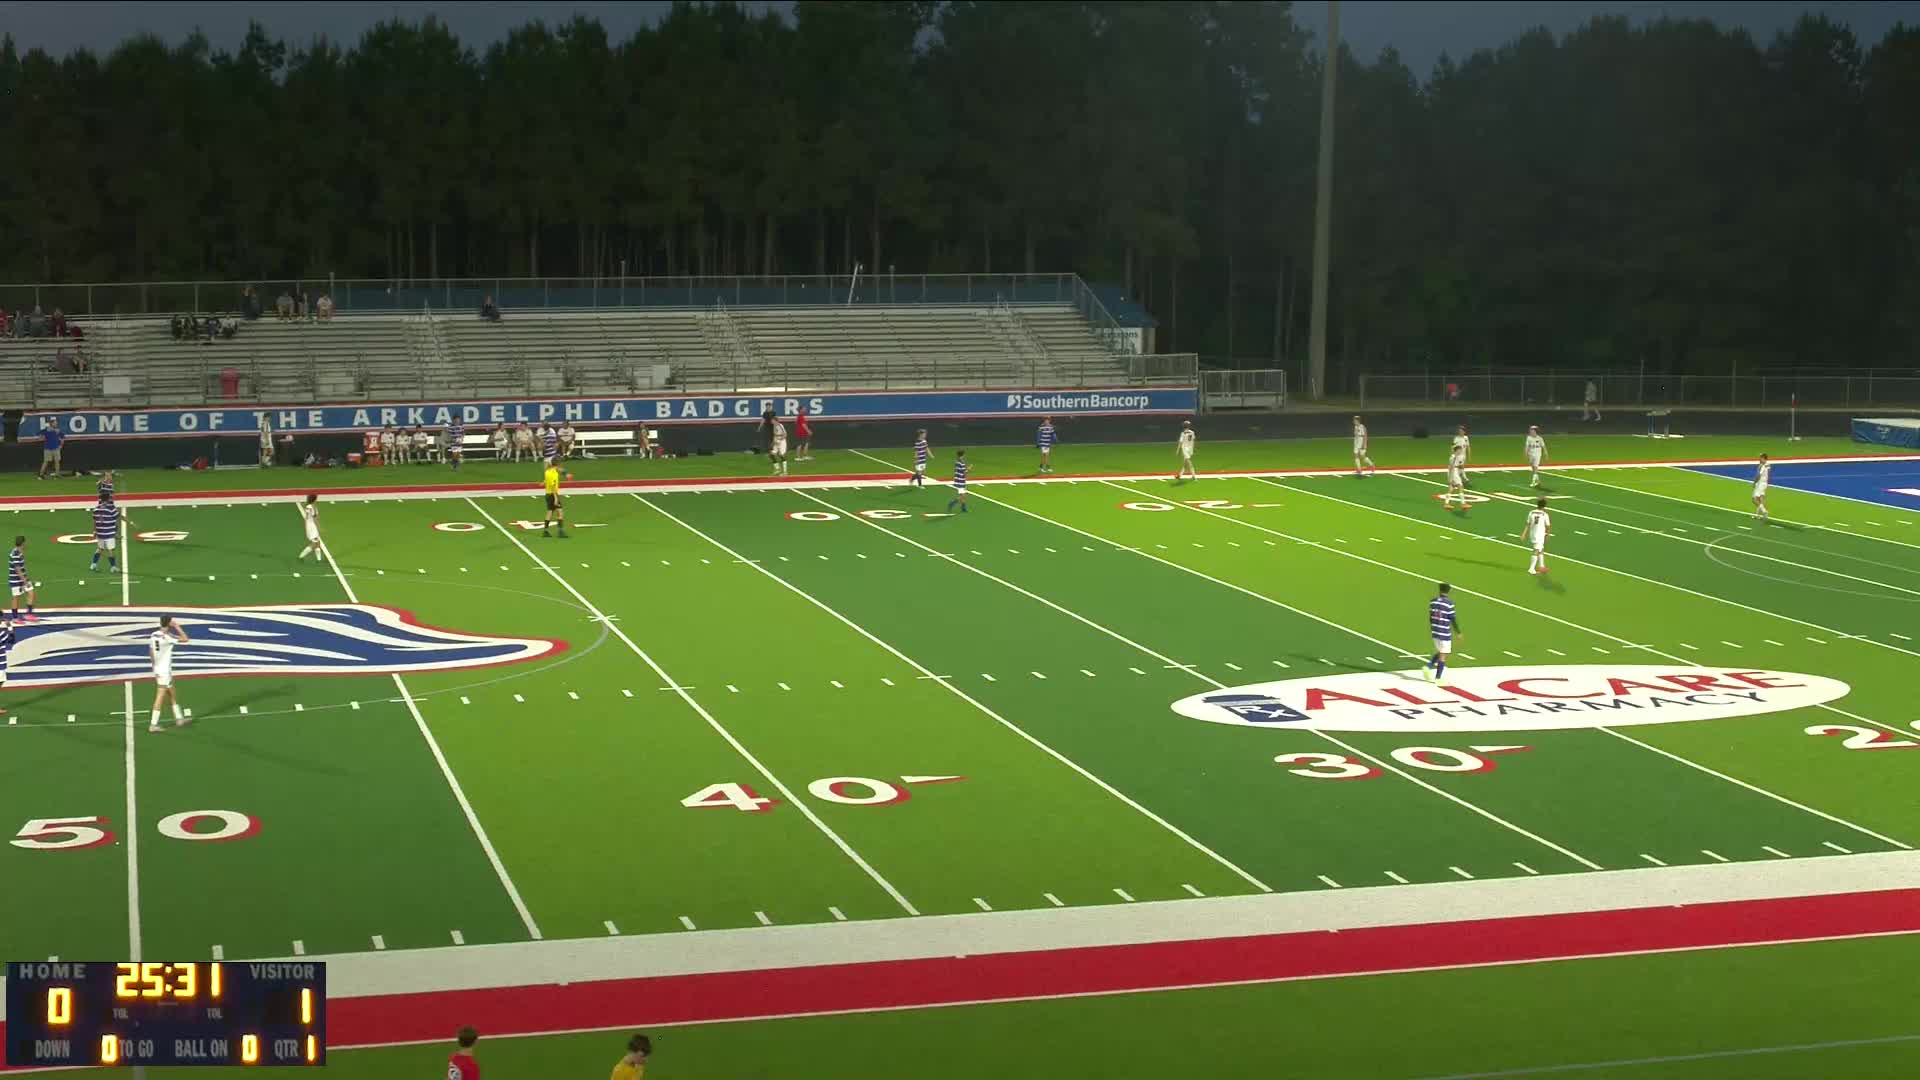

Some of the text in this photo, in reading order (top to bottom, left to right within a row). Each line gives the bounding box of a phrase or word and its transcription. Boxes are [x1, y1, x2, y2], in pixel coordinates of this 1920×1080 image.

[40, 414, 149, 433] HOME
[179, 412, 224, 430] OF
[253, 410, 323, 429] THE
[352, 402, 628, 426] ARKADELPHIA
[1306, 671, 1808, 711] ALLCARE
[1388, 692, 1768, 720] PHARMACY
[1803, 719, 1920, 750] 2
